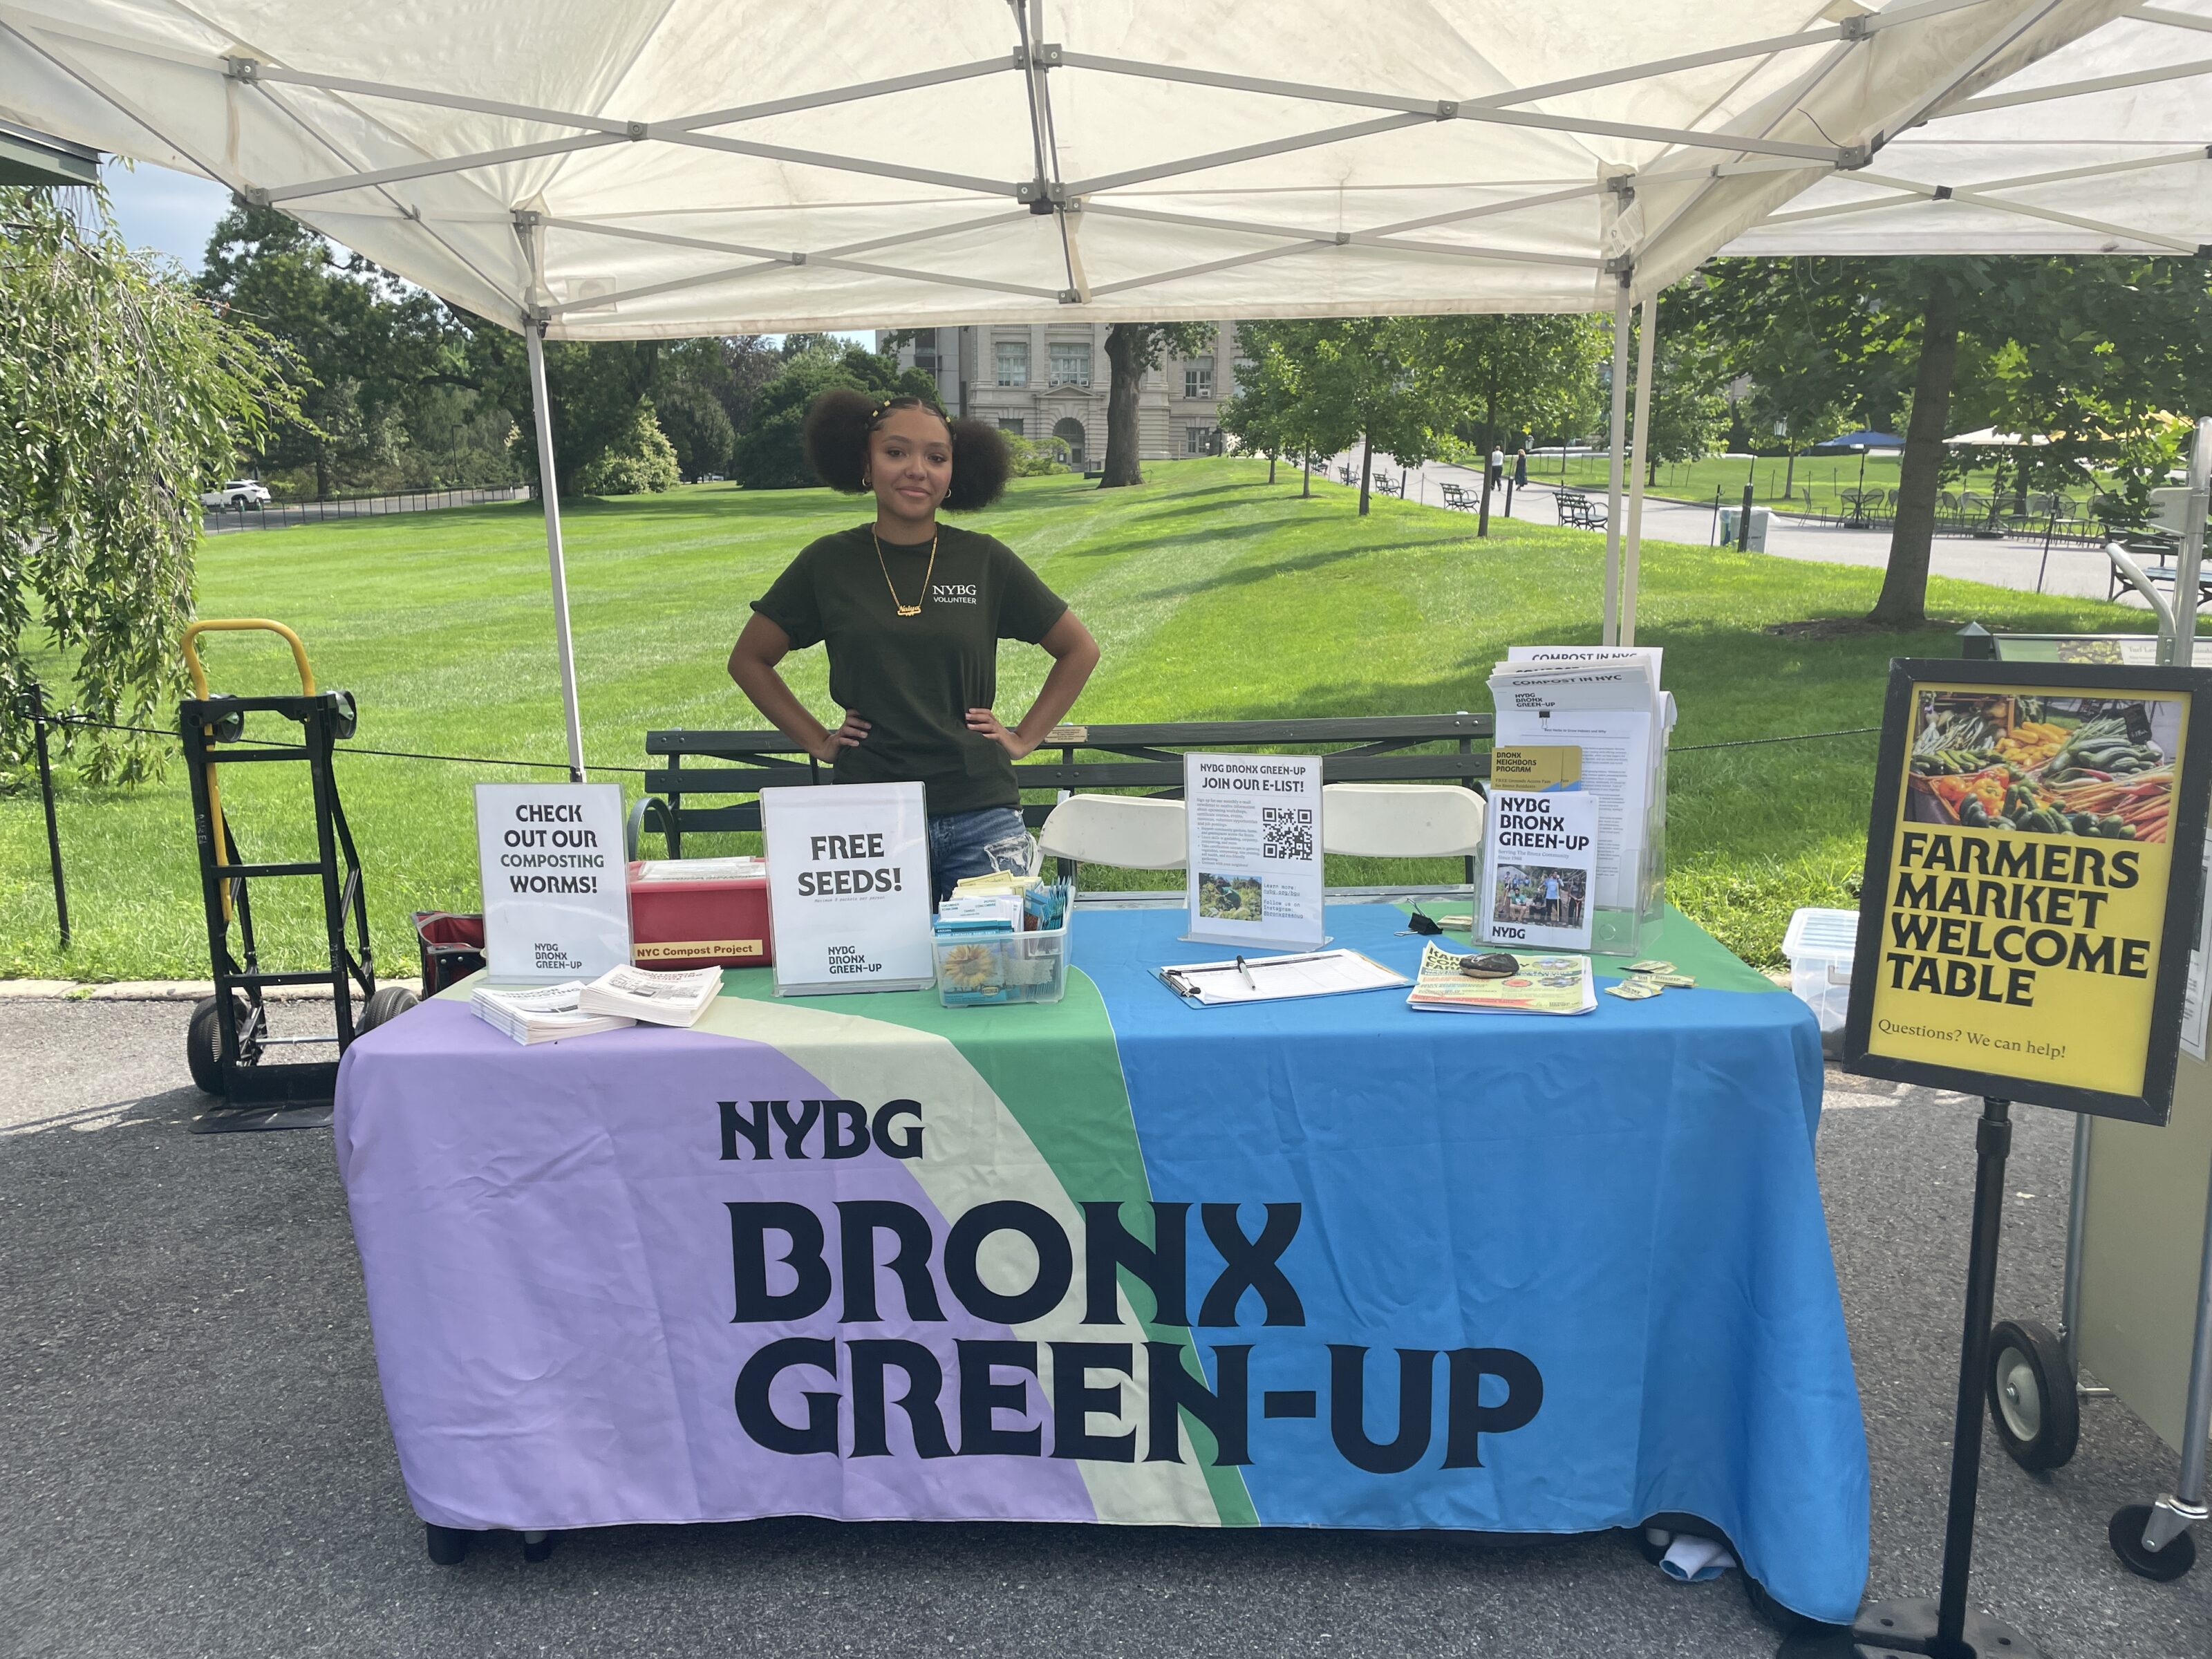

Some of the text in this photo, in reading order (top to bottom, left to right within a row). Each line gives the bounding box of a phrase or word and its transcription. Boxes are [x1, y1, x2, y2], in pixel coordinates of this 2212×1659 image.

[932, 584, 977, 595] NYBG
[933, 597, 977, 605] VOLUNTEER
[1200, 763, 1306, 776] NYBG BRONX GREEN-UP
[1202, 777, 1304, 792] JOIN OUR E-LIST!
[515, 805, 583, 823] CHECK
[1501, 797, 1550, 814] NYBG
[1499, 814, 1565, 832] BRONX
[504, 830, 598, 848] OUT OUR
[810, 833, 885, 861] FREE
[1499, 832, 1590, 850] GREEN-UP
[500, 854, 605, 868] COMPOSTING
[1899, 832, 2140, 890] FARMERS
[509, 876, 598, 894] WORMS!
[798, 868, 902, 897] SEEDS!
[1893, 872, 2109, 929] MARKET
[1492, 926, 1526, 939] NYBG
[534, 943, 559, 952] NYBG
[637, 944, 753, 957] NYC Compost Project
[828, 946, 855, 955] NYBG
[1891, 912, 2151, 980] WELCOME
[534, 951, 568, 961] BRONX
[536, 960, 582, 969] GREEN-UP
[828, 955, 865, 964] BRONX
[829, 963, 882, 974] GREEN-UP
[1886, 953, 2036, 1007] TABLE
[1878, 1019, 2067, 1060] Questions? We can help!
[717, 1099, 926, 1161] NYBG
[723, 1199, 1306, 1327] BRONX
[735, 1337, 1544, 1474] GREEN-UP
